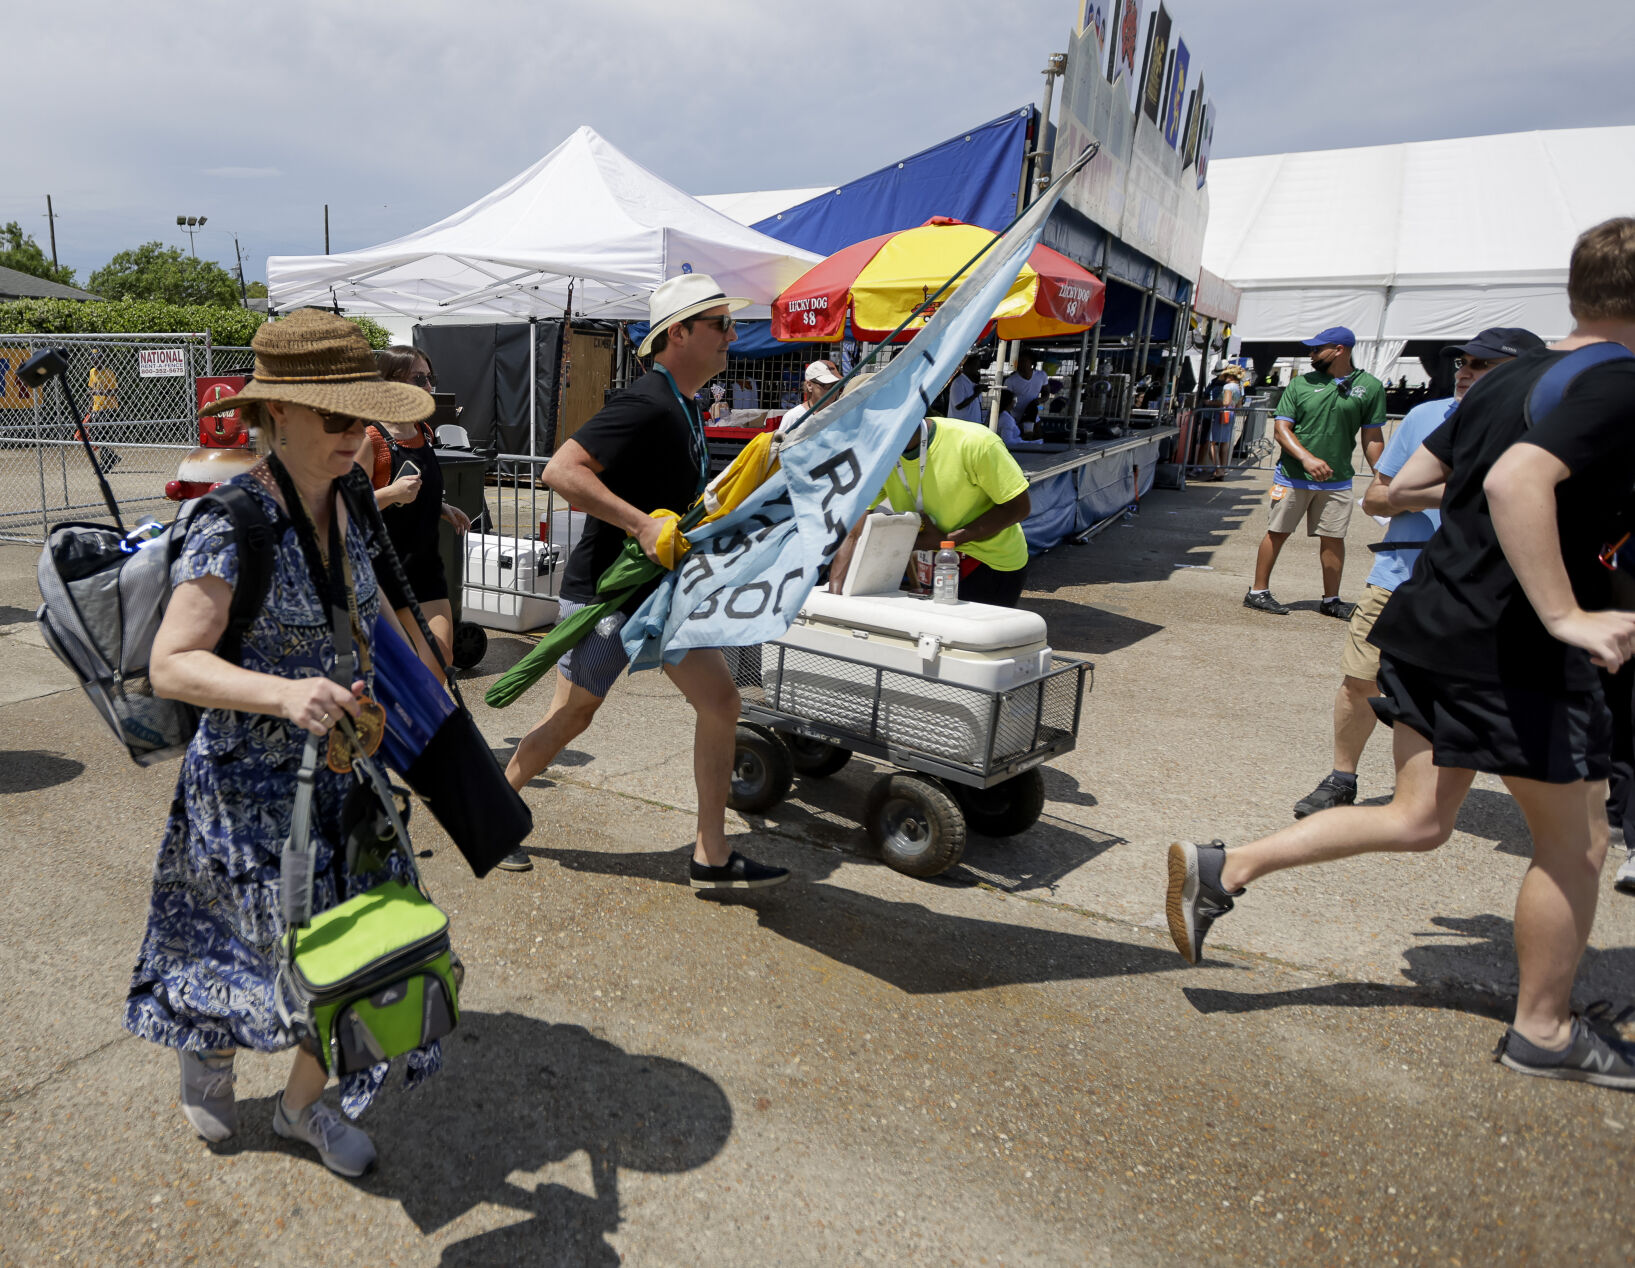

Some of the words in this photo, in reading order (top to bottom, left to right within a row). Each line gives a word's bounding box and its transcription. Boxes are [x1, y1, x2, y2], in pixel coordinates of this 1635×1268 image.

[789, 299, 810, 312] LUCKY
[811, 297, 828, 310] DOG
[803, 311, 817, 326] $8
[140, 351, 183, 363] NATIONAL
